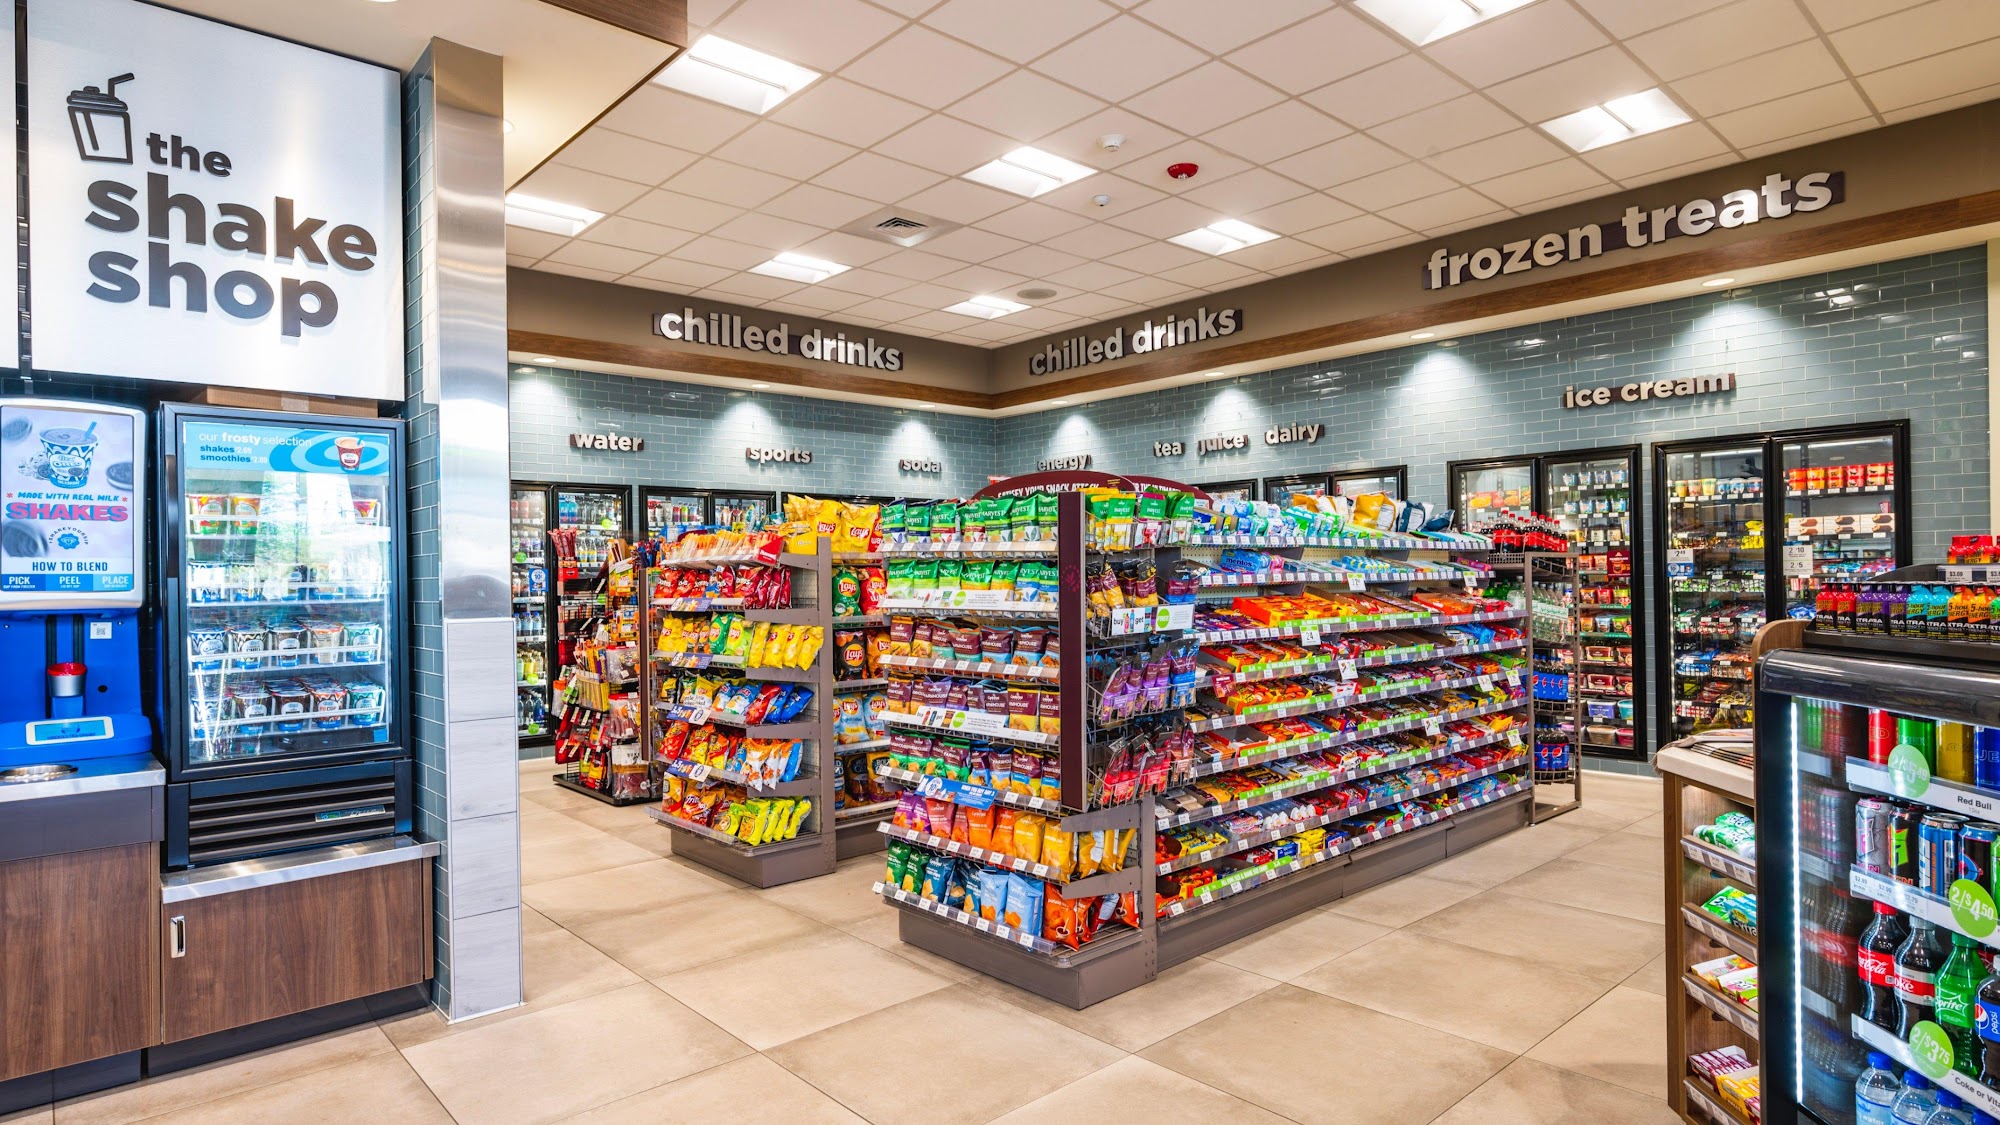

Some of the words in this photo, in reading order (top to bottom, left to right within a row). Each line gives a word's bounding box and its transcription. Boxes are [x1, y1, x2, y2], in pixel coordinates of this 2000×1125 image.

[146, 131, 232, 177] the
[85, 172, 377, 271] shake
[1428, 222, 1602, 289] frozen
[1622, 171, 1833, 248] treats
[86, 242, 338, 337] shop
[659, 307, 789, 355] chilled
[800, 328, 902, 371] drinks
[1031, 327, 1124, 376] chilled
[1132, 307, 1236, 354] drinks
[1566, 385, 1611, 409] ice
[1621, 372, 1731, 401] cream
[198, 433, 218, 442] our
[221, 432, 261, 446] frosty
[263, 435, 312, 447] selection
[1265, 421, 1320, 445] dairy
[200, 445, 235, 453] shakes
[573, 432, 643, 452] water
[1154, 439, 1183, 457] tea
[1198, 431, 1246, 455] juice
[200, 454, 251, 463] smoothies
[749, 447, 812, 464] sports
[1037, 453, 1090, 471] energy
[902, 457, 941, 473] soda
[72, 493, 94, 501] REAL
[1046, 483, 1069, 494] SNACK
[5, 502, 128, 522] SHAKES
[818, 522, 836, 533] Lay's
[850, 526, 870, 538] Lay's
[32, 561, 57, 571] HOW
[61, 561, 72, 571] TO
[77, 561, 108, 571] BLEND
[1226, 558, 1252, 567] mentos
[8, 576, 31, 585] PICK
[59, 576, 81, 585] PEEL
[101, 575, 129, 584] PLACE
[846, 649, 863, 661] Lay's
[1957, 795, 1974, 806] Red
[1975, 799, 1992, 810] Bull
[1990, 1011, 2000, 1034] pepsi
[1954, 1077, 1975, 1093] Coke
[1976, 1089, 1985, 1099] or
